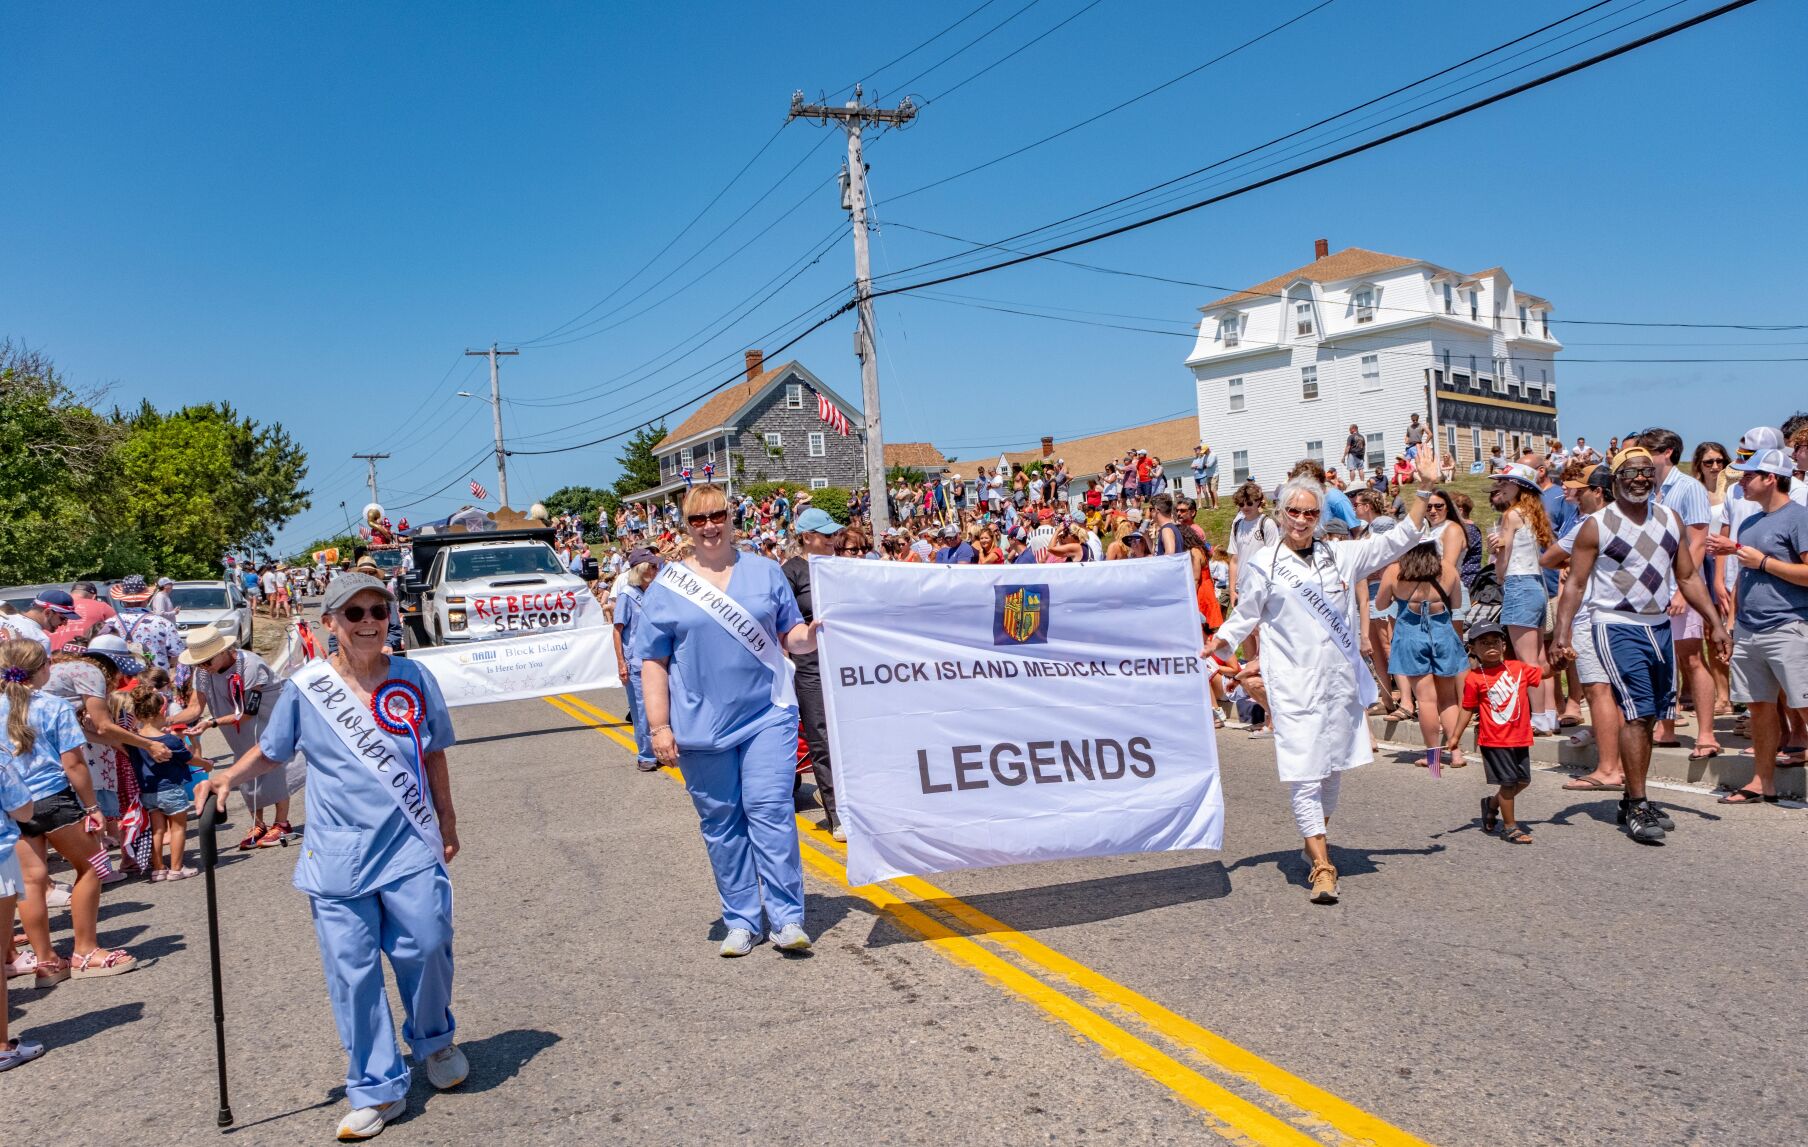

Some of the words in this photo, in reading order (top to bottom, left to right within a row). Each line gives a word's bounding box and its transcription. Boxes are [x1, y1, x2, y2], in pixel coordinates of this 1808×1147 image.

[494, 612, 571, 632] SEAFOOD
[662, 565, 702, 597] MARY
[700, 590, 766, 652] DONNELLY
[495, 663, 514, 673] Here
[515, 662, 527, 670] for
[528, 661, 543, 669] You
[505, 645, 535, 658] Block
[538, 642, 568, 654] Island
[840, 661, 930, 687] BLOCK
[936, 659, 1019, 681] ISLAND
[1023, 659, 1115, 678] MEDICAL
[1119, 656, 1200, 677] CENTER
[1487, 670, 1518, 710] NIKE
[307, 674, 347, 710] DR
[336, 707, 396, 773] WADE
[917, 736, 1156, 795] LEGENDS
